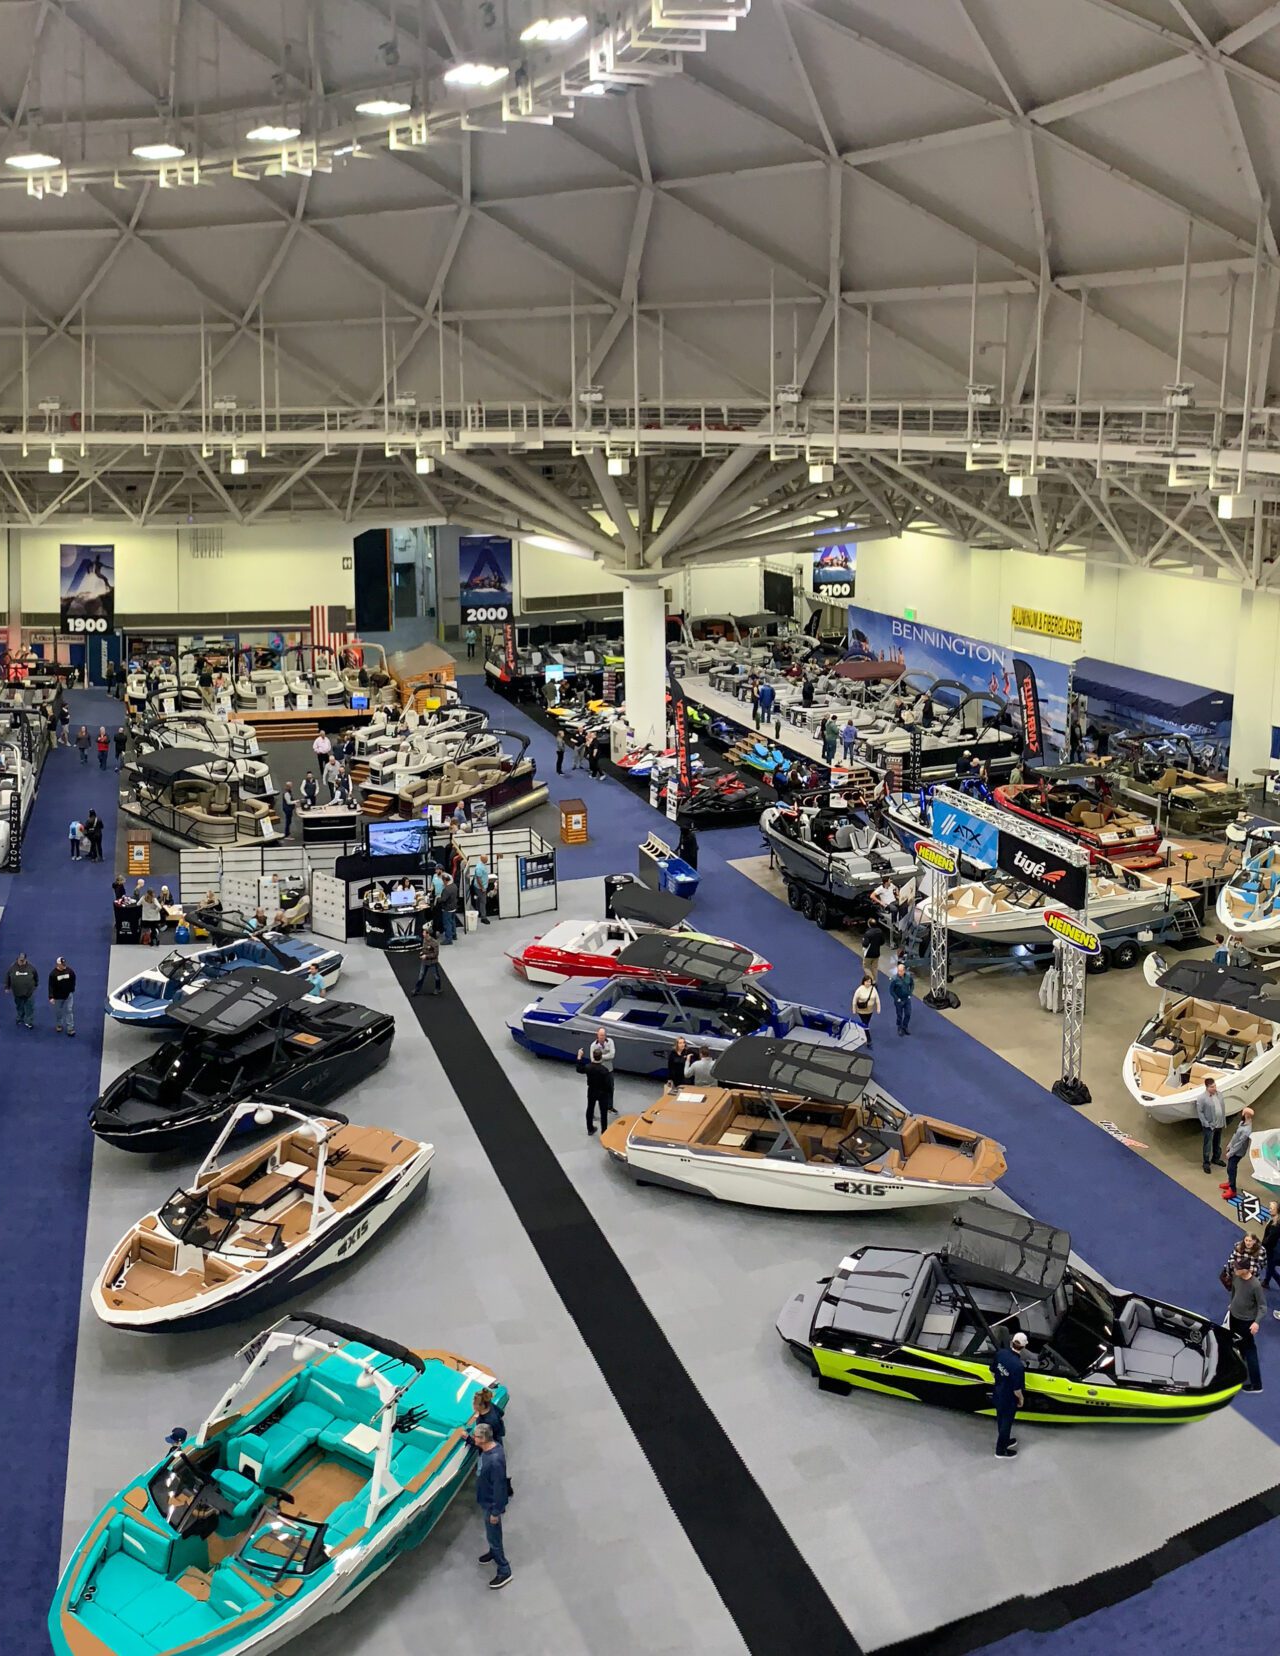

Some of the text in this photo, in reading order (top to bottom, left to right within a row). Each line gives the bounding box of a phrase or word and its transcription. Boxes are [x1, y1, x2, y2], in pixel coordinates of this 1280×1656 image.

[820, 583, 850, 596] 2100
[67, 617, 108, 632] 1900
[466, 607, 508, 621] 2000
[892, 620, 1006, 666] BENNINGTON
[10, 796, 18, 862] BENNINGTON
[953, 824, 983, 845] ATX
[918, 845, 955, 873] HEINEN'S
[1048, 914, 1098, 950] HEINEN'S
[834, 1182, 886, 1196] AXIS
[1241, 1190, 1263, 1224] ATX
[337, 1220, 369, 1256] AXIS
